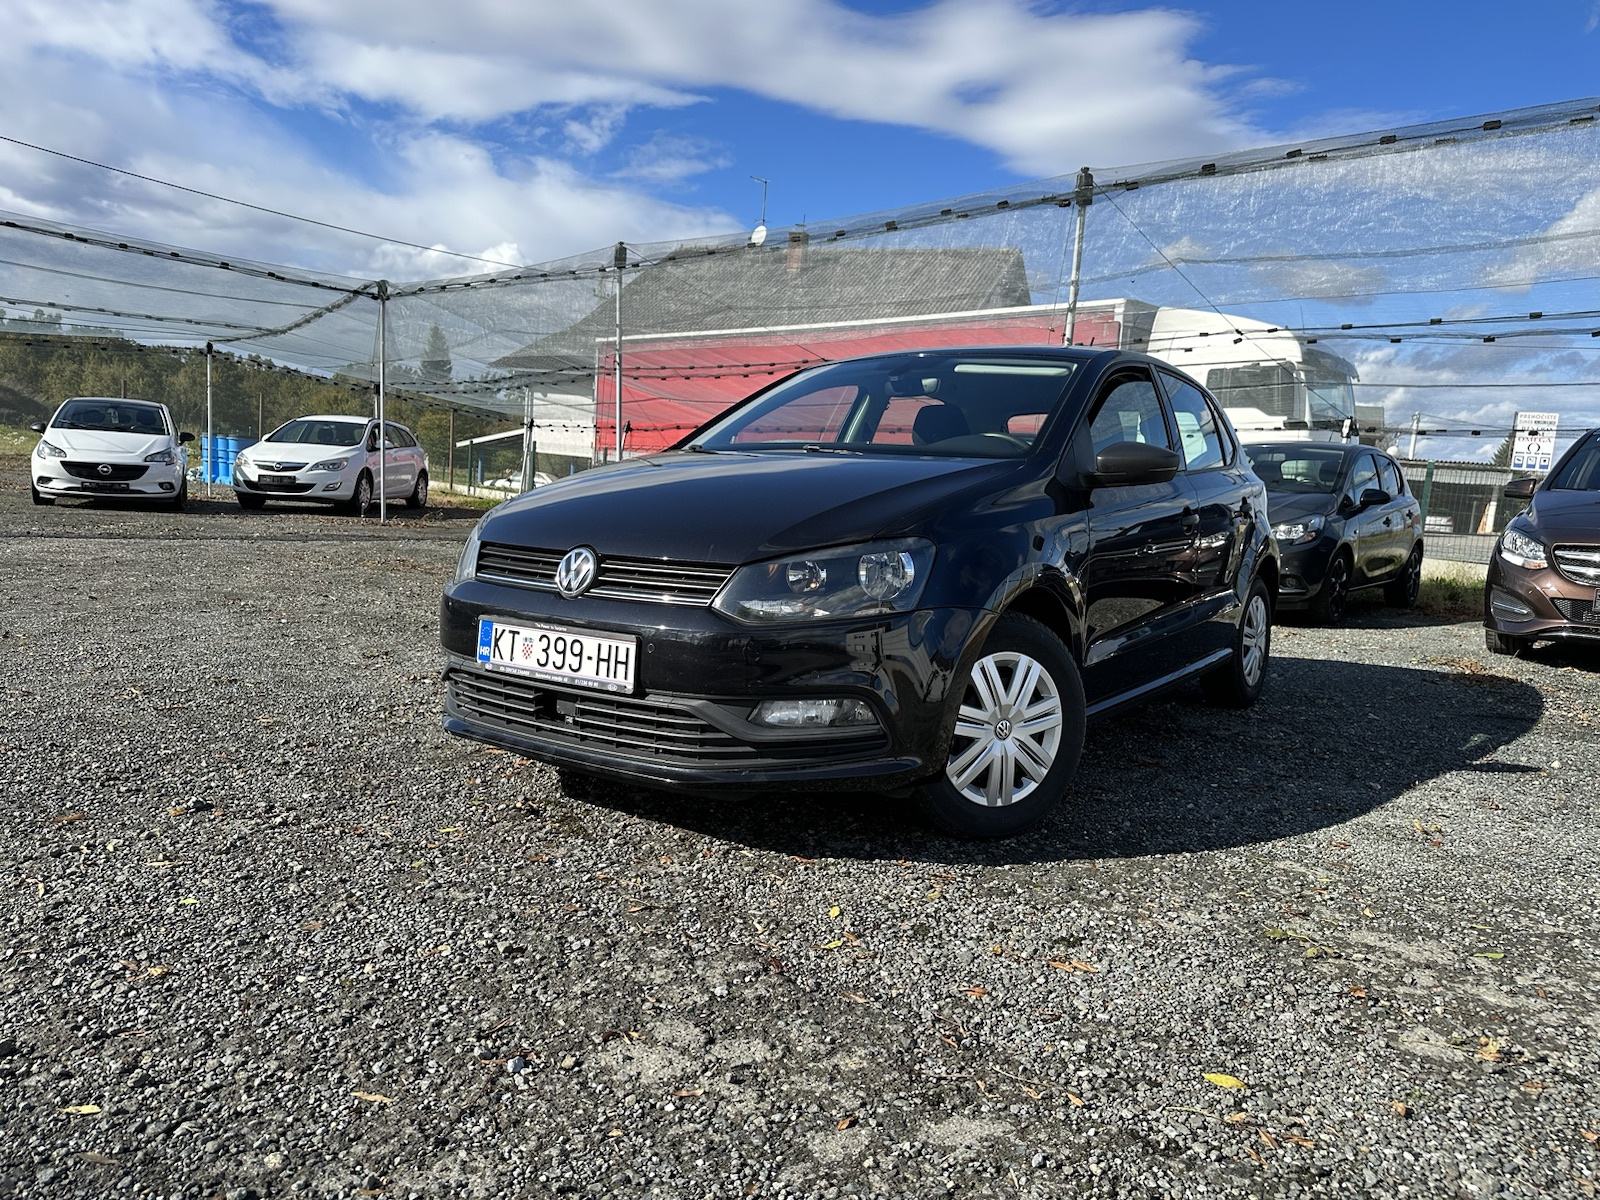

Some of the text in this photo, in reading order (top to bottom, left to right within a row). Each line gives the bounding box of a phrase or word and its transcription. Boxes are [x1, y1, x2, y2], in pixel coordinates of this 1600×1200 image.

[479, 646, 490, 656] HR
[493, 627, 630, 680] KT 399-HH
